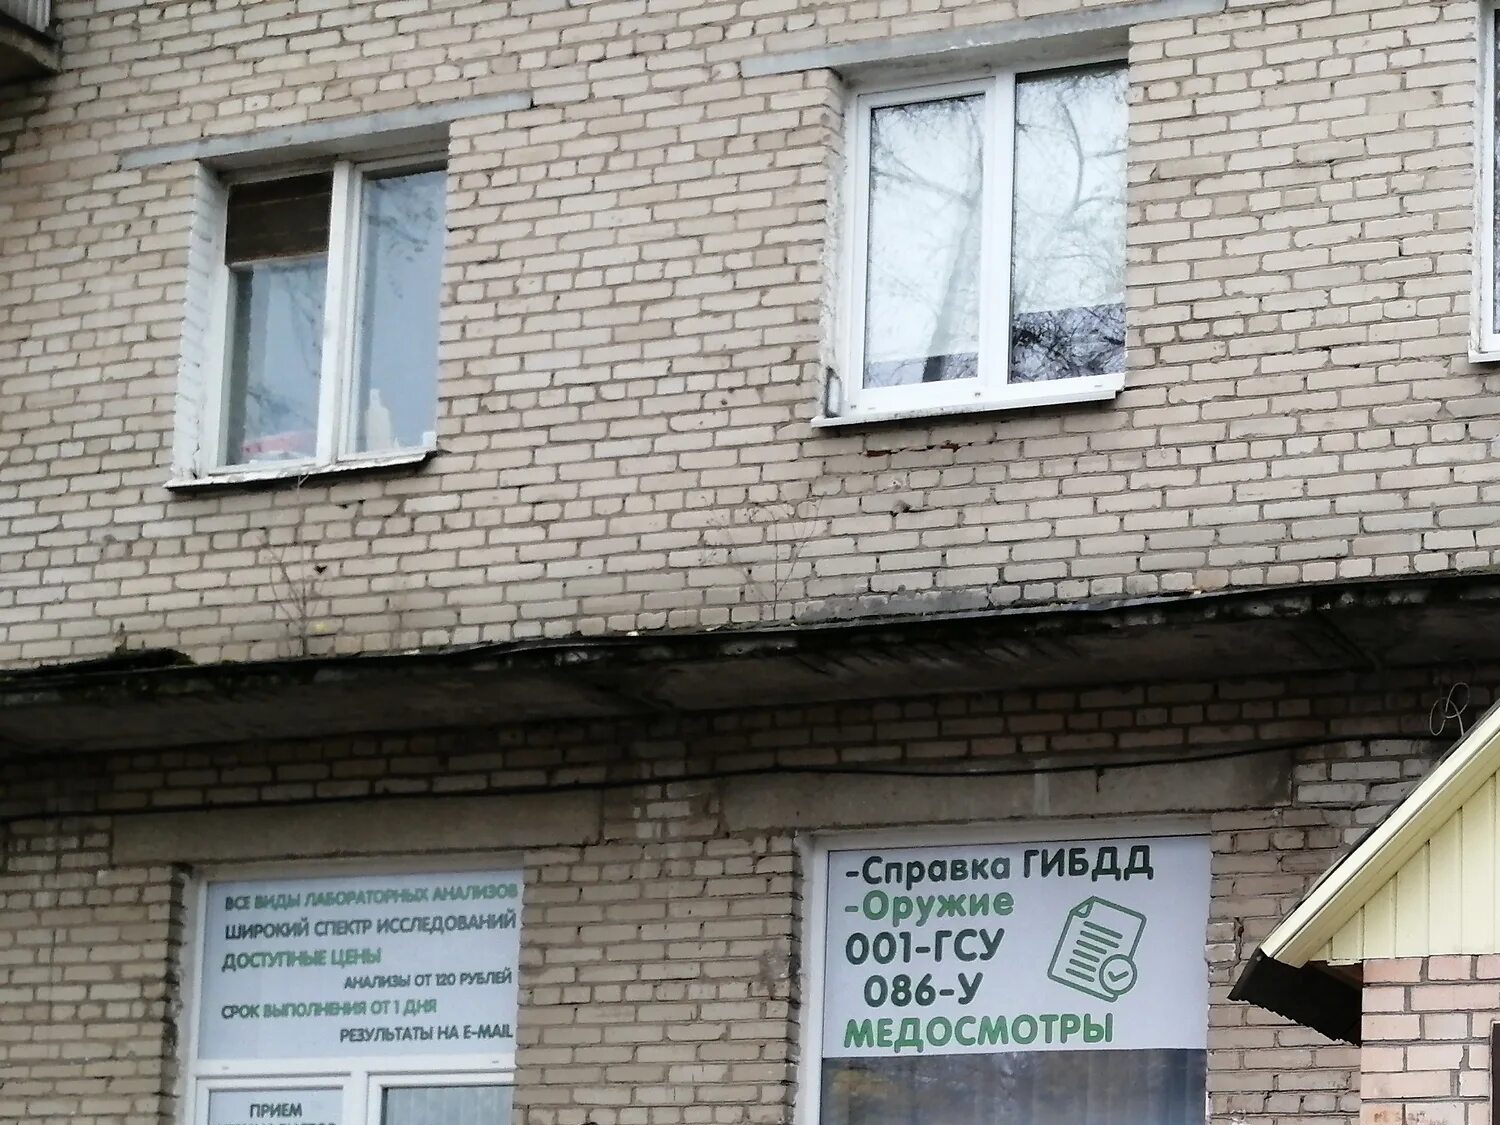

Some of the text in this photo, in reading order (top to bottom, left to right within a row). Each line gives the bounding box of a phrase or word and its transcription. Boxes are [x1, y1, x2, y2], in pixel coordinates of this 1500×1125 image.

[845, 844, 1155, 890] -Справка ГИБДД
[225, 883, 518, 911] ВСЕ ВИДЫ ЛАБОРАТОРНЫХ АНАЛИЗОВ
[844, 890, 1015, 927] -Оружие
[225, 908, 516, 940] ШИРОКИЙ СПЕКТР ИССЛЕДОВАНИЙ
[222, 947, 381, 972] ДОСТУПНЫЕ ЦЕНЫ
[845, 928, 1005, 965] 001-ГСУ
[344, 966, 512, 989] АНАЛИЗЫ ОТ 120 РУБЛЕЙ
[863, 972, 984, 1008] 086-У
[221, 998, 437, 1019] СРОК ВЫПОЛНЕНИЯ ОТ 1 ДНЯ
[340, 1024, 513, 1043] РЕЗУЛЬТАТЫ НА E-MAIL
[843, 1013, 1114, 1053] МЕДОСМОТРЫ
[250, 1102, 302, 1118] ПРИЕМ
